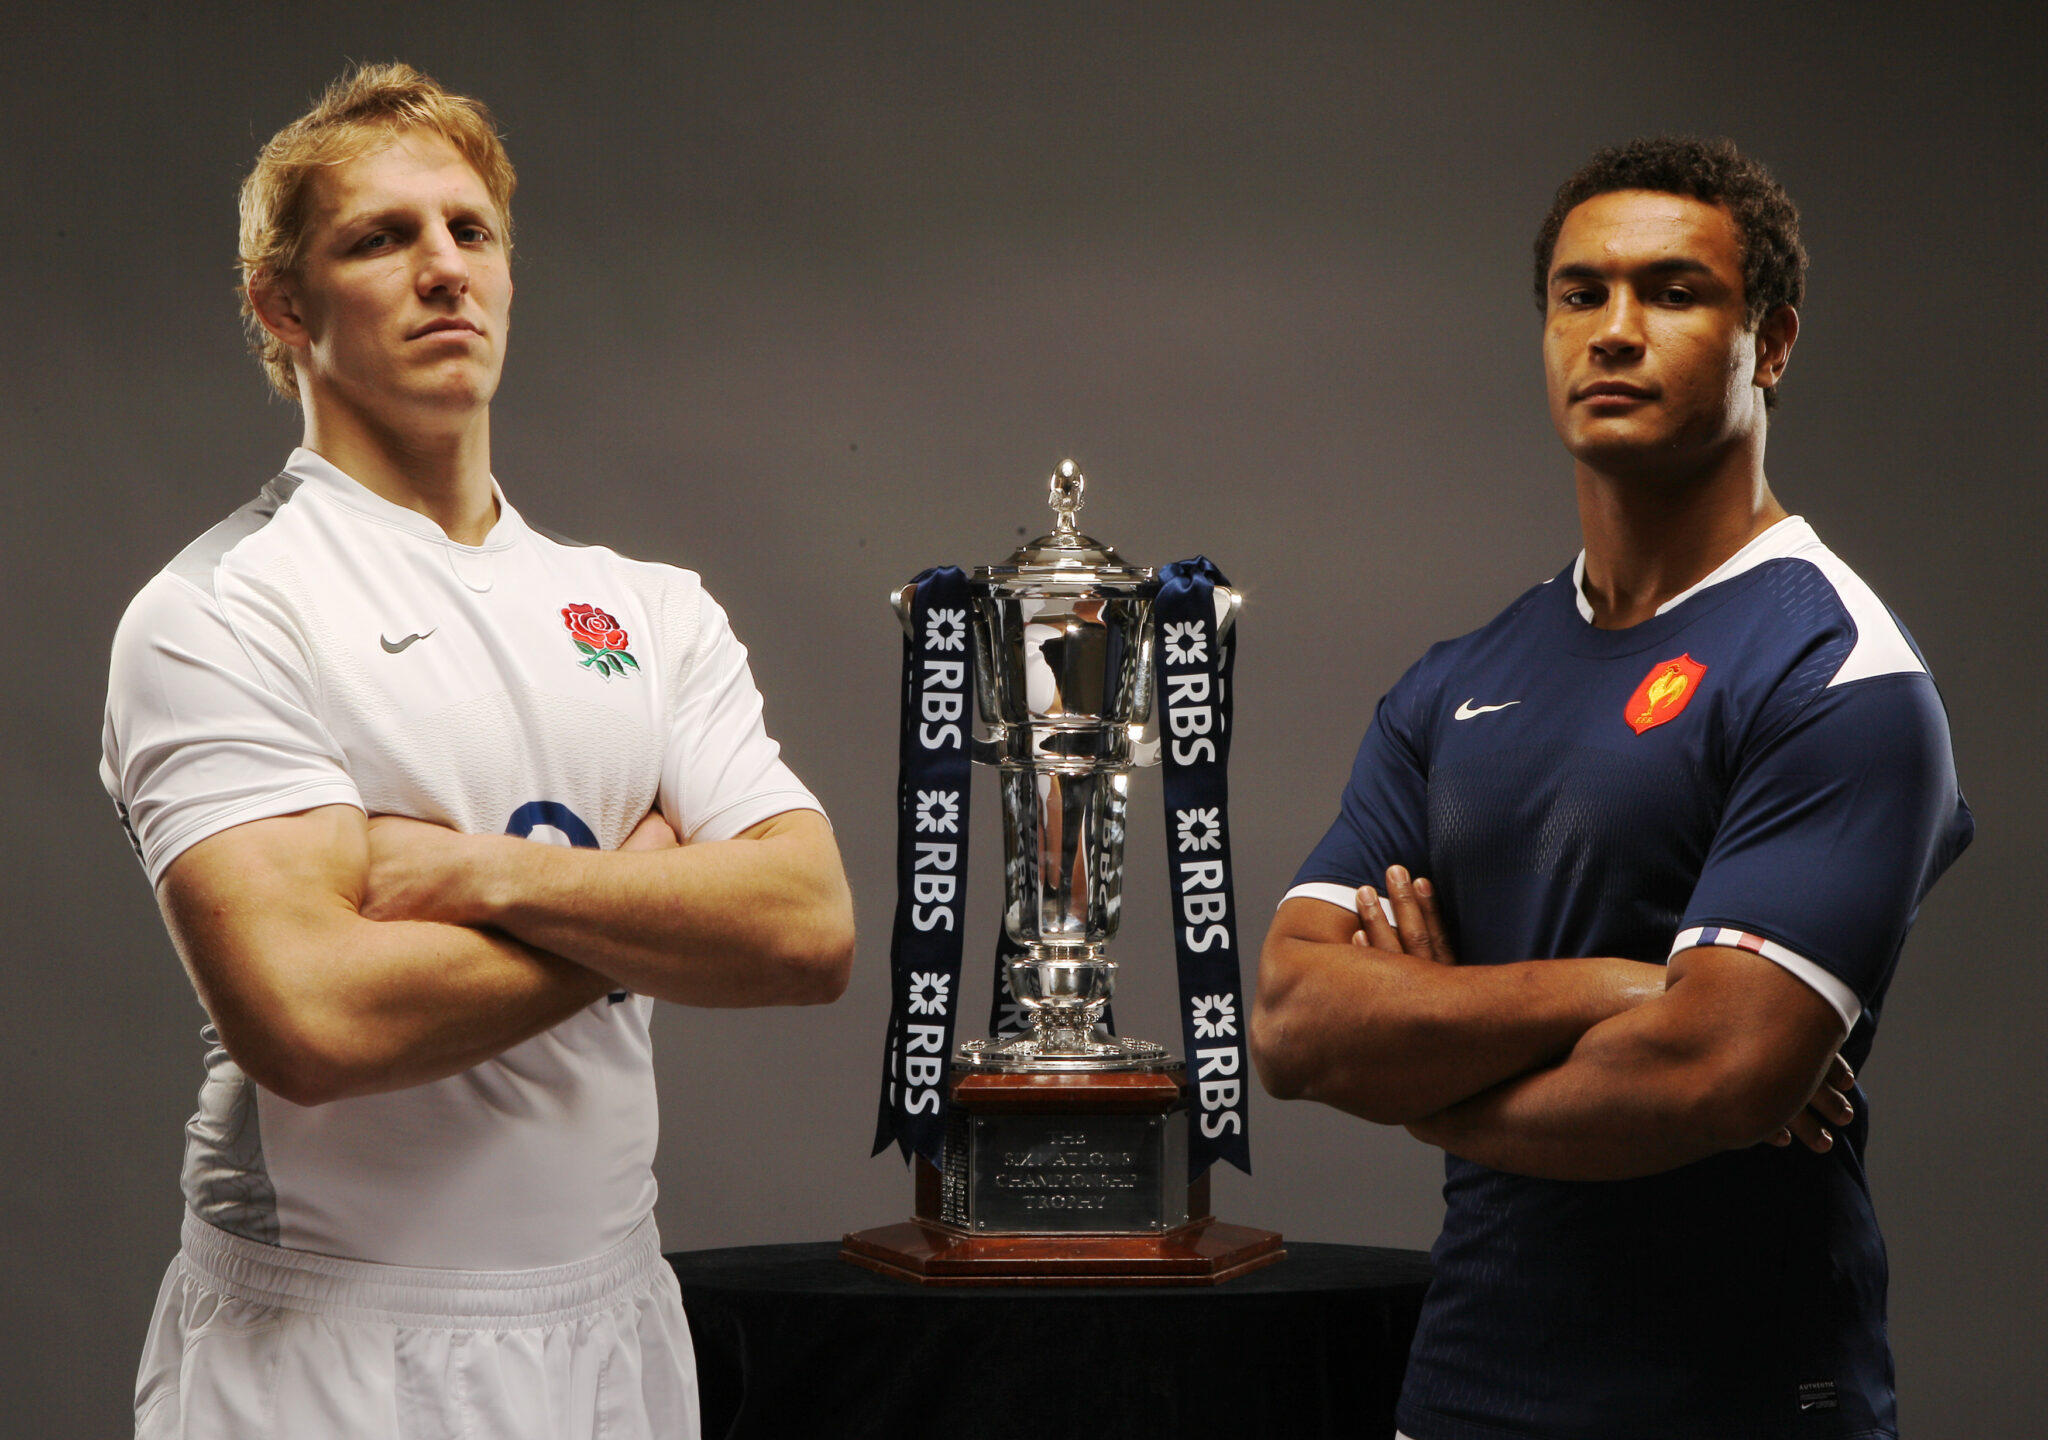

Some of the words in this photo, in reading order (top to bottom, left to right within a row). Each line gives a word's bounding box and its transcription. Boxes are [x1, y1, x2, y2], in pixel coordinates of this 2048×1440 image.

[919, 660, 965, 750] RBS
[1166, 672, 1216, 766] RBS
[911, 842, 958, 932] RBS
[1180, 859, 1230, 953] RBS
[904, 1024, 945, 1115] RBS
[1195, 1046, 1241, 1139] RBS
